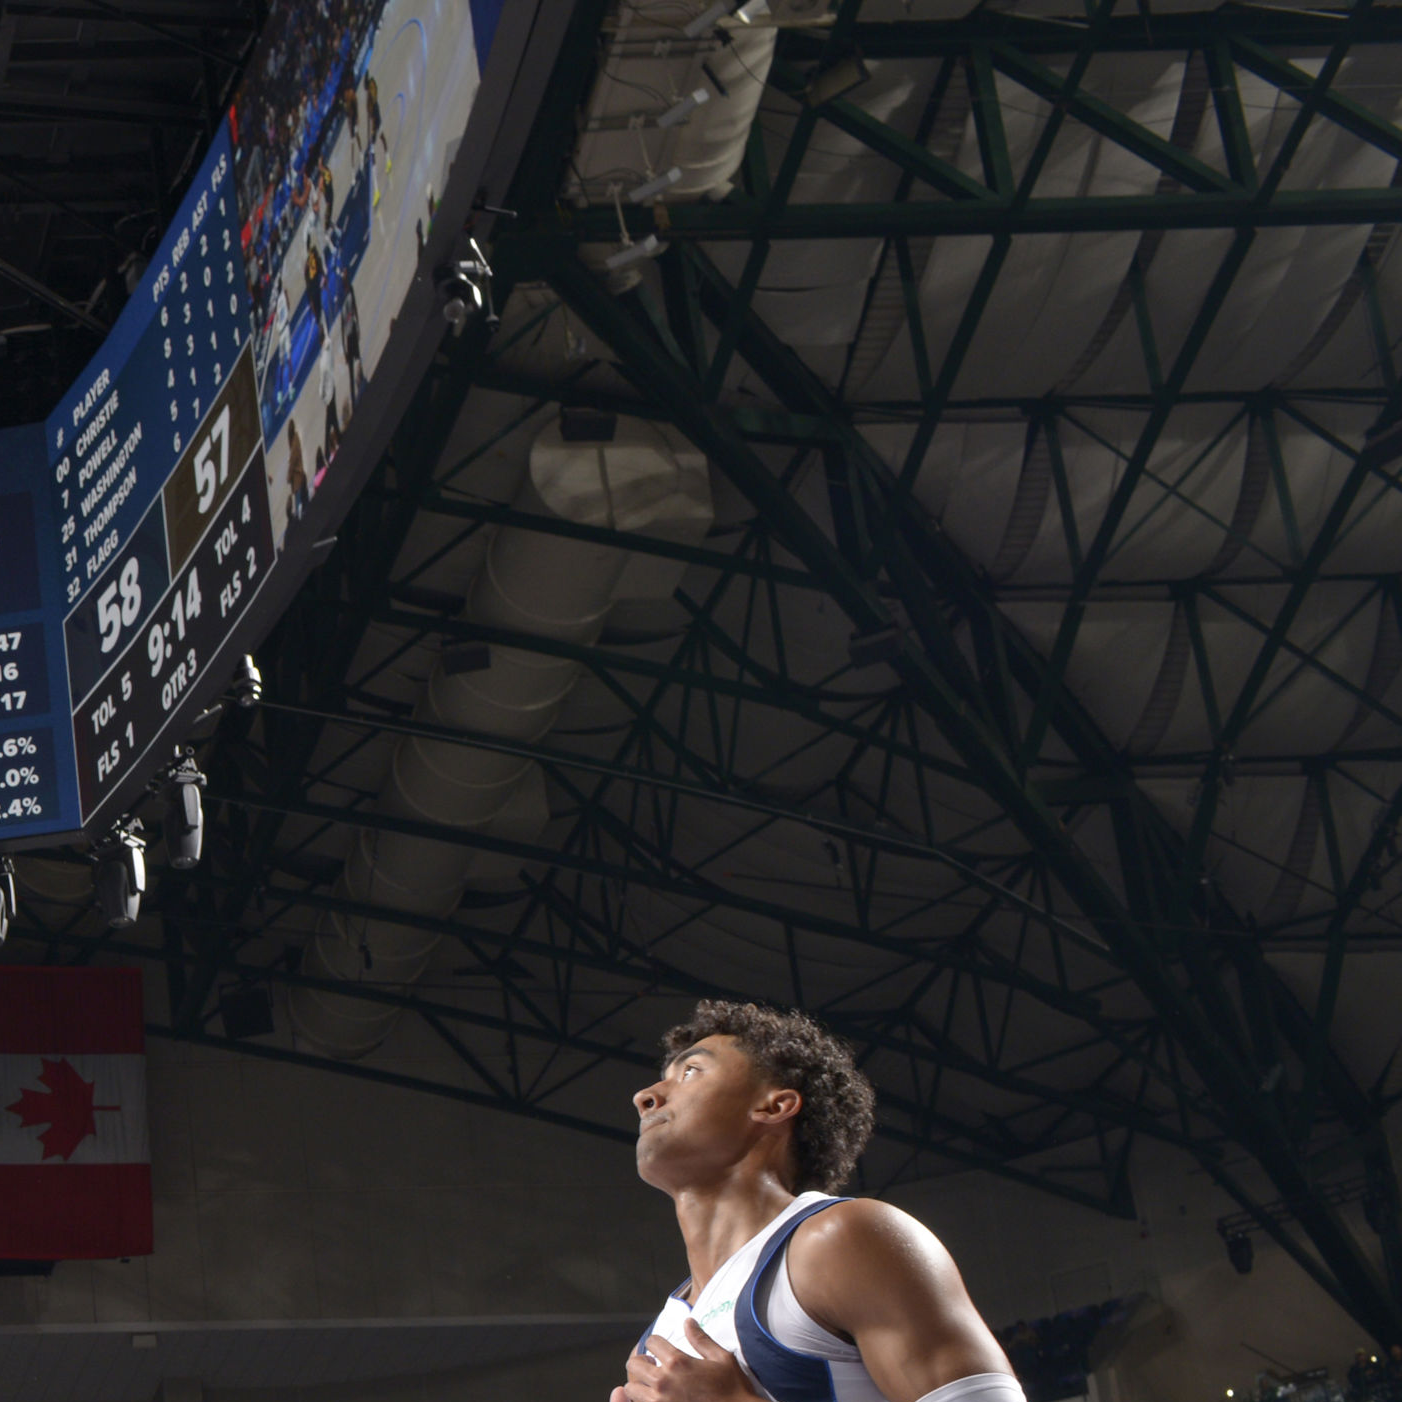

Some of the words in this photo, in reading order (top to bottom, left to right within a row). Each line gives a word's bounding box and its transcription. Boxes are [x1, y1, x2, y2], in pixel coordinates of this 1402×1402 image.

[73, 369, 110, 427] PLAYER
[76, 390, 119, 458] CHRISTIE
[78, 430, 117, 488] POWELL
[81, 422, 143, 518] WASHINGTON
[195, 406, 231, 513] 57
[84, 466, 137, 548] THOMPSON
[87, 530, 119, 579] FLAGG
[97, 556, 141, 653] 58
[148, 566, 201, 677] 9:14
